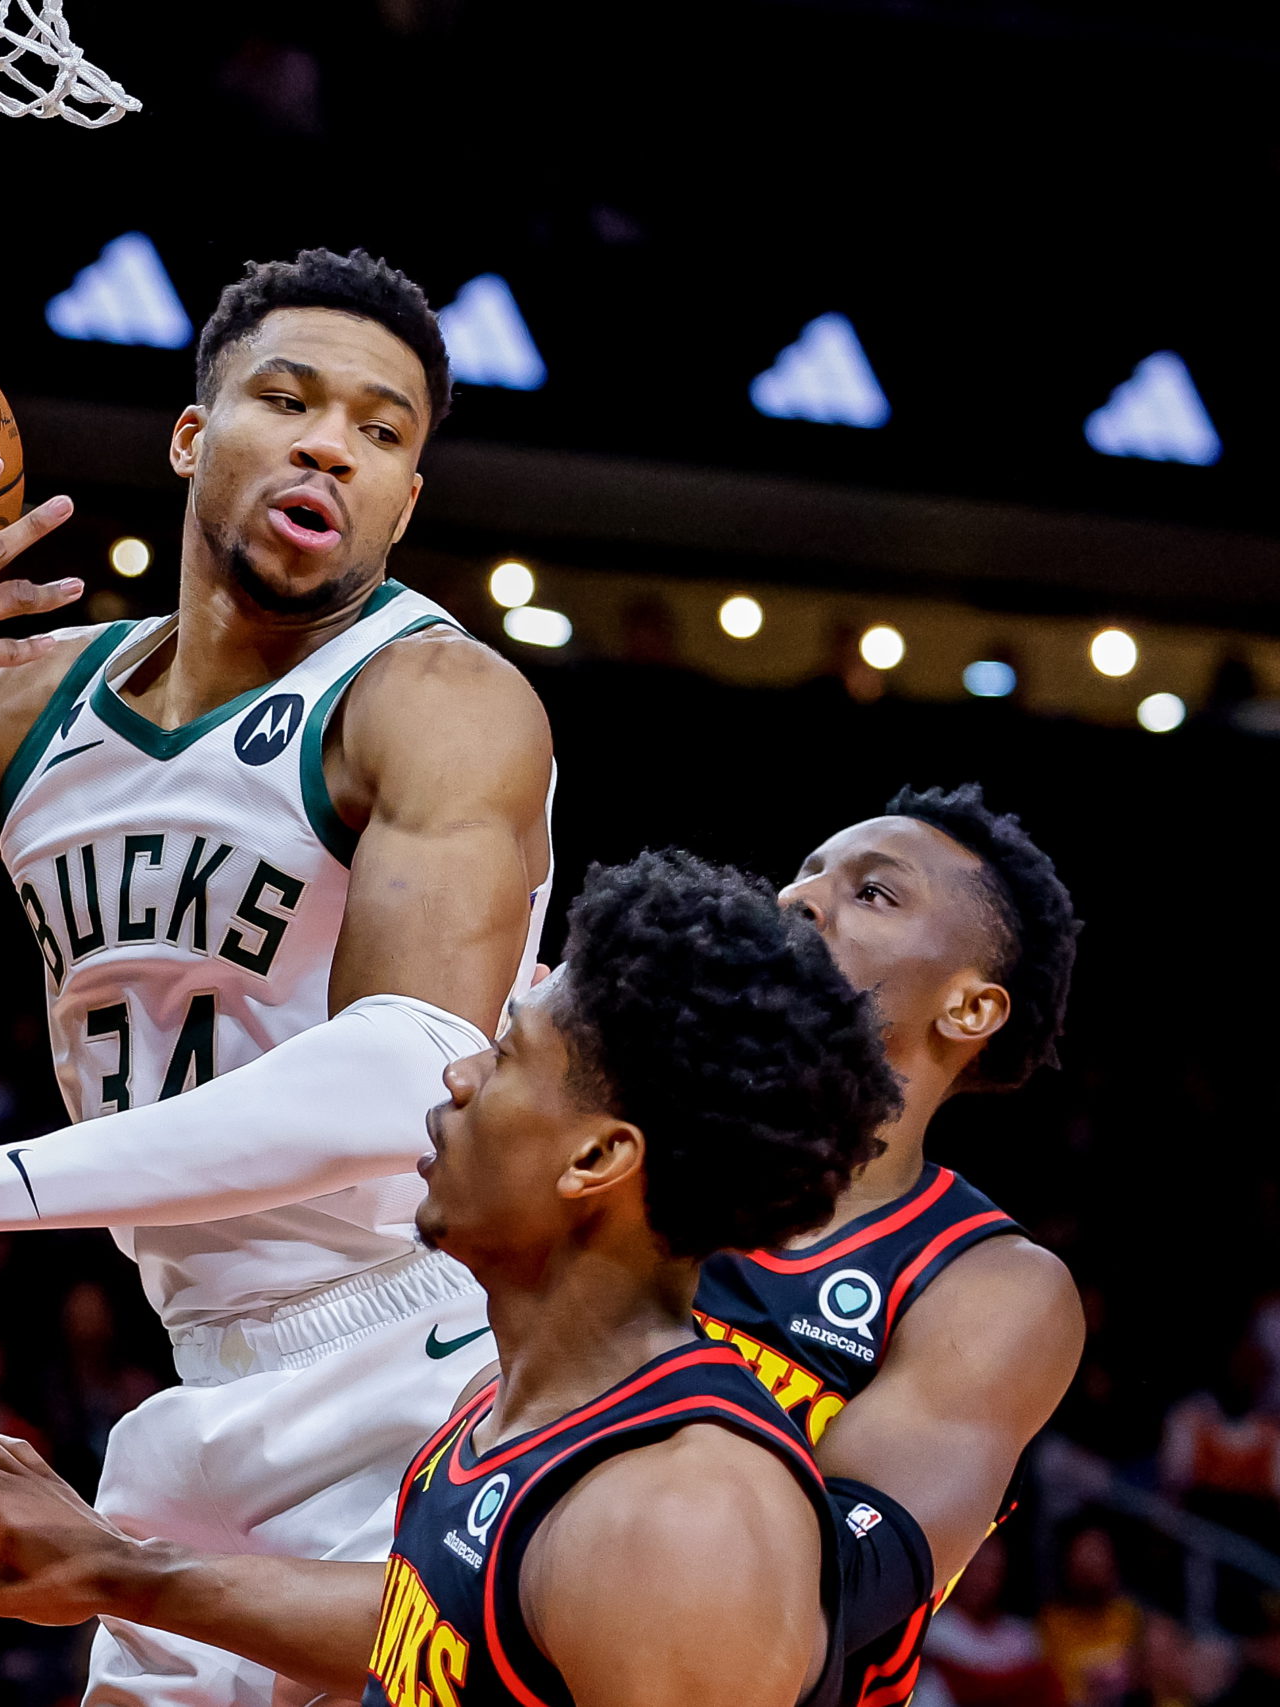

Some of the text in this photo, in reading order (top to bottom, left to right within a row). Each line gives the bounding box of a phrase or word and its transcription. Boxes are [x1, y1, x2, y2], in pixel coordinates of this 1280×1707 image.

[19, 830, 310, 994] BUCKS
[789, 1318, 875, 1362] sharecare
[443, 1529, 484, 1570] sharecare
